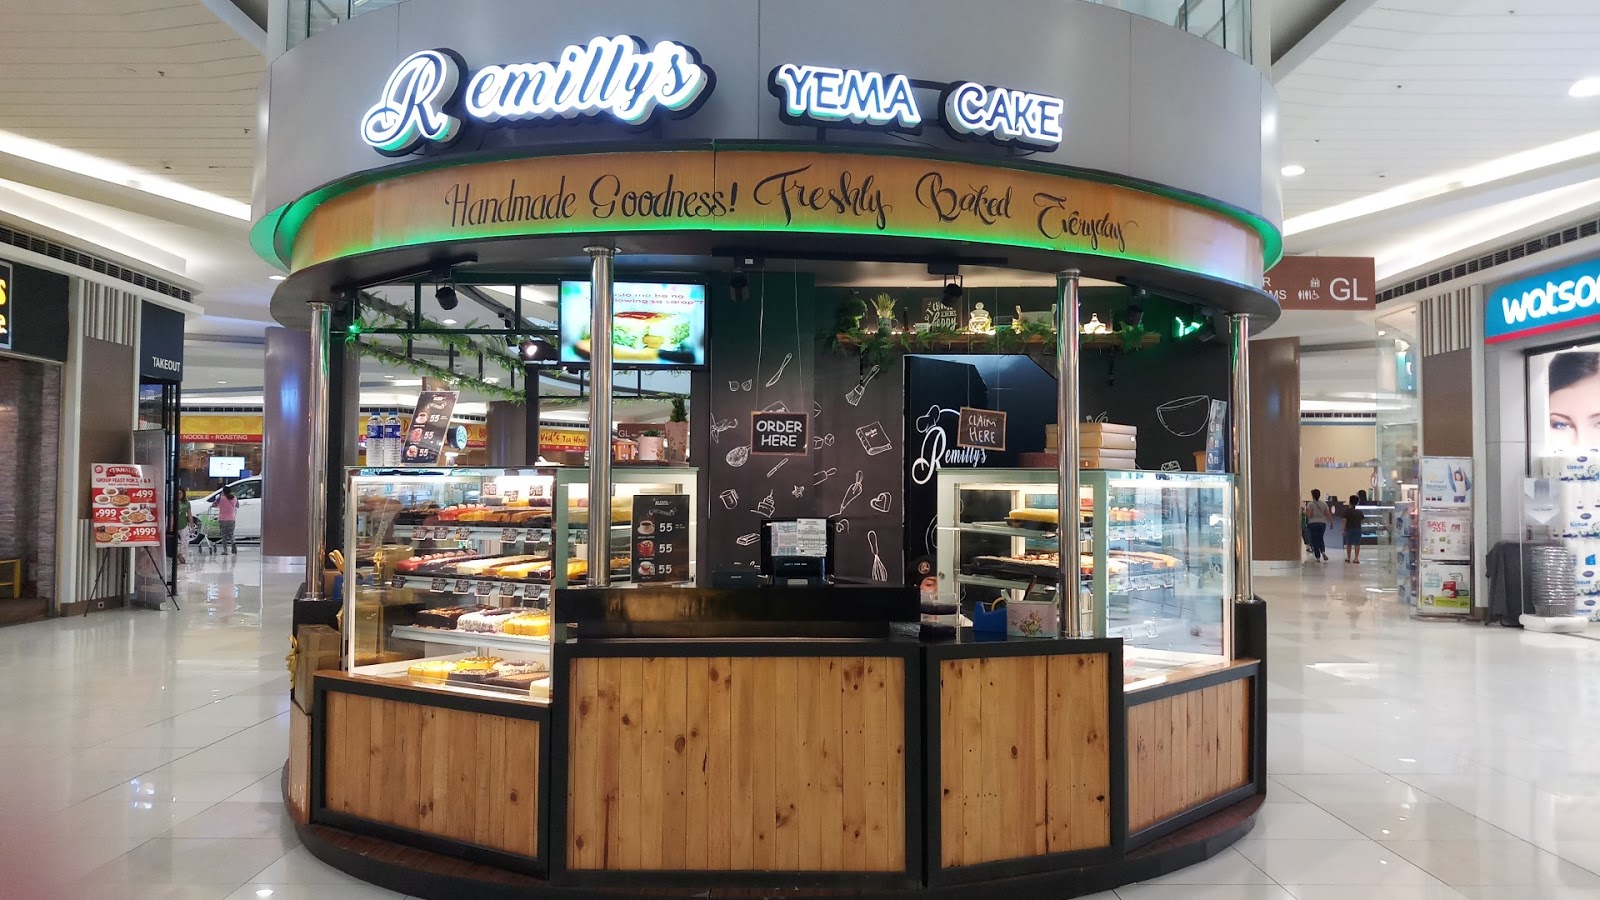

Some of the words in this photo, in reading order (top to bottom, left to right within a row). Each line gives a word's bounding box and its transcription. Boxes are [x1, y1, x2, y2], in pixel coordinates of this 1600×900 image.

[775, 63, 922, 126] YEMA
[950, 82, 1064, 145] CAKE
[444, 174, 578, 228] Handmade
[588, 172, 739, 219] Goodness!
[753, 164, 893, 230] Freshly
[915, 171, 1013, 226] Baked
[1033, 192, 1139, 253] Everyday
[1329, 277, 1368, 301] GL
[1502, 273, 1600, 325] watso
[152, 356, 181, 372] TAKEOUT
[429, 414, 440, 423] 55
[756, 420, 803, 433] ORDER
[423, 431, 434, 439] 55
[761, 434, 797, 447] HERE
[969, 427, 996, 444] HERE
[418, 448, 429, 457] 55
[659, 522, 673, 532] 55
[658, 543, 673, 553] 55
[658, 564, 673, 574] 55
